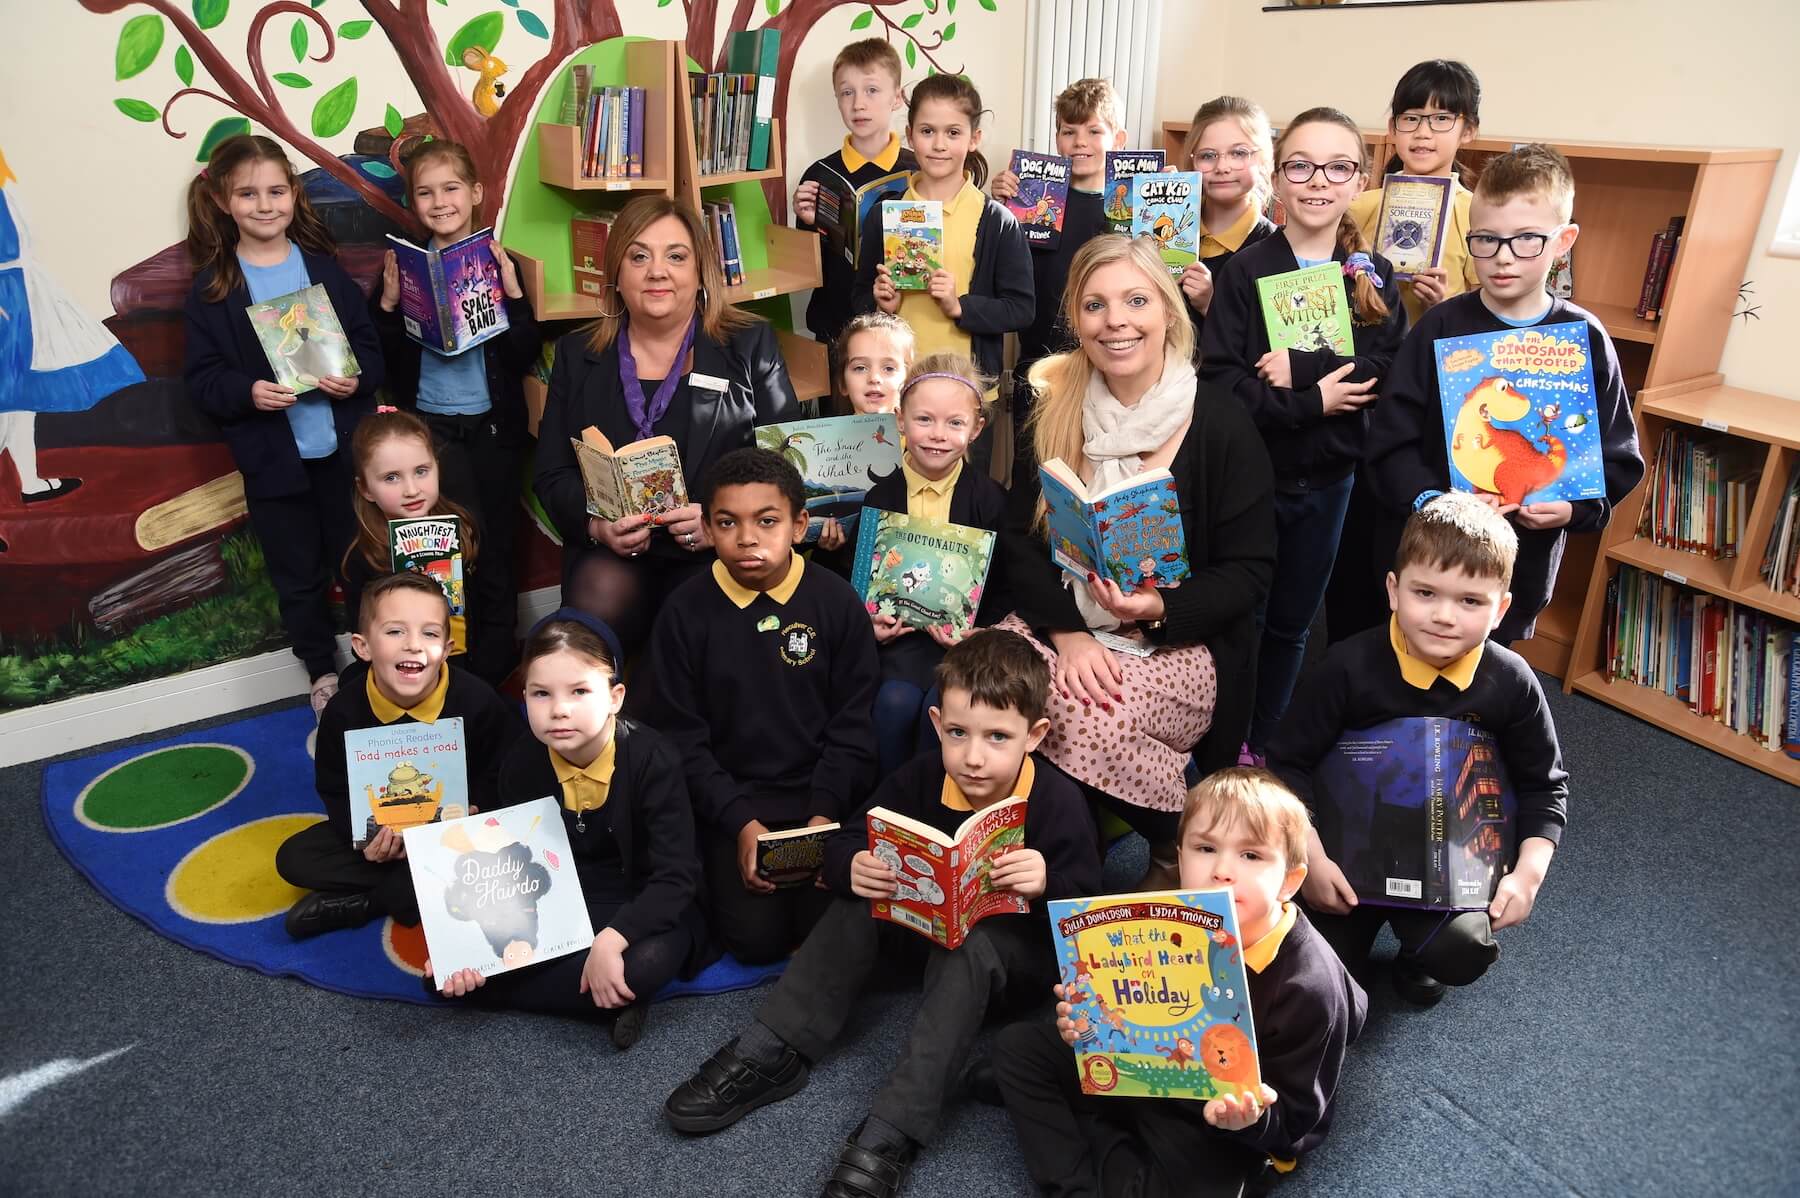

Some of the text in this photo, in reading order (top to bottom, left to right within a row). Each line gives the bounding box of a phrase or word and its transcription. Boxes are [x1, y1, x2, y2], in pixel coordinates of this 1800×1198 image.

[1020, 158, 1067, 179] DOG MAN
[1113, 158, 1159, 172] DOG MAN
[1140, 182, 1165, 198] CAT
[1390, 208, 1433, 220] SORCERESS
[1275, 278, 1299, 290] FIRST
[461, 288, 494, 320] SPACE
[468, 308, 497, 337] BAND
[1280, 302, 1337, 327] WITCH
[1497, 343, 1577, 357] DINOSAUR
[1495, 357, 1577, 368] THAT POOPED
[1515, 377, 1590, 394] CHRISTMAS
[814, 438, 866, 456] The Snail
[817, 462, 862, 479] Whale
[398, 524, 455, 541] NAUGHTIEST
[402, 537, 450, 554] UNICORN
[907, 532, 970, 556] OCTONAUTS
[367, 732, 443, 748] Phonics Readers
[354, 740, 458, 763] Toad makes a road
[461, 855, 525, 885] Daddy
[474, 875, 540, 909] Hairdo
[1063, 905, 1221, 935] JULIA DONALDSON LYDIA MONKS
[1105, 928, 1168, 947] What the
[1088, 948, 1205, 974] Ladybird Heard
[1141, 970, 1155, 980] on
[1111, 976, 1199, 1017] Holiday
